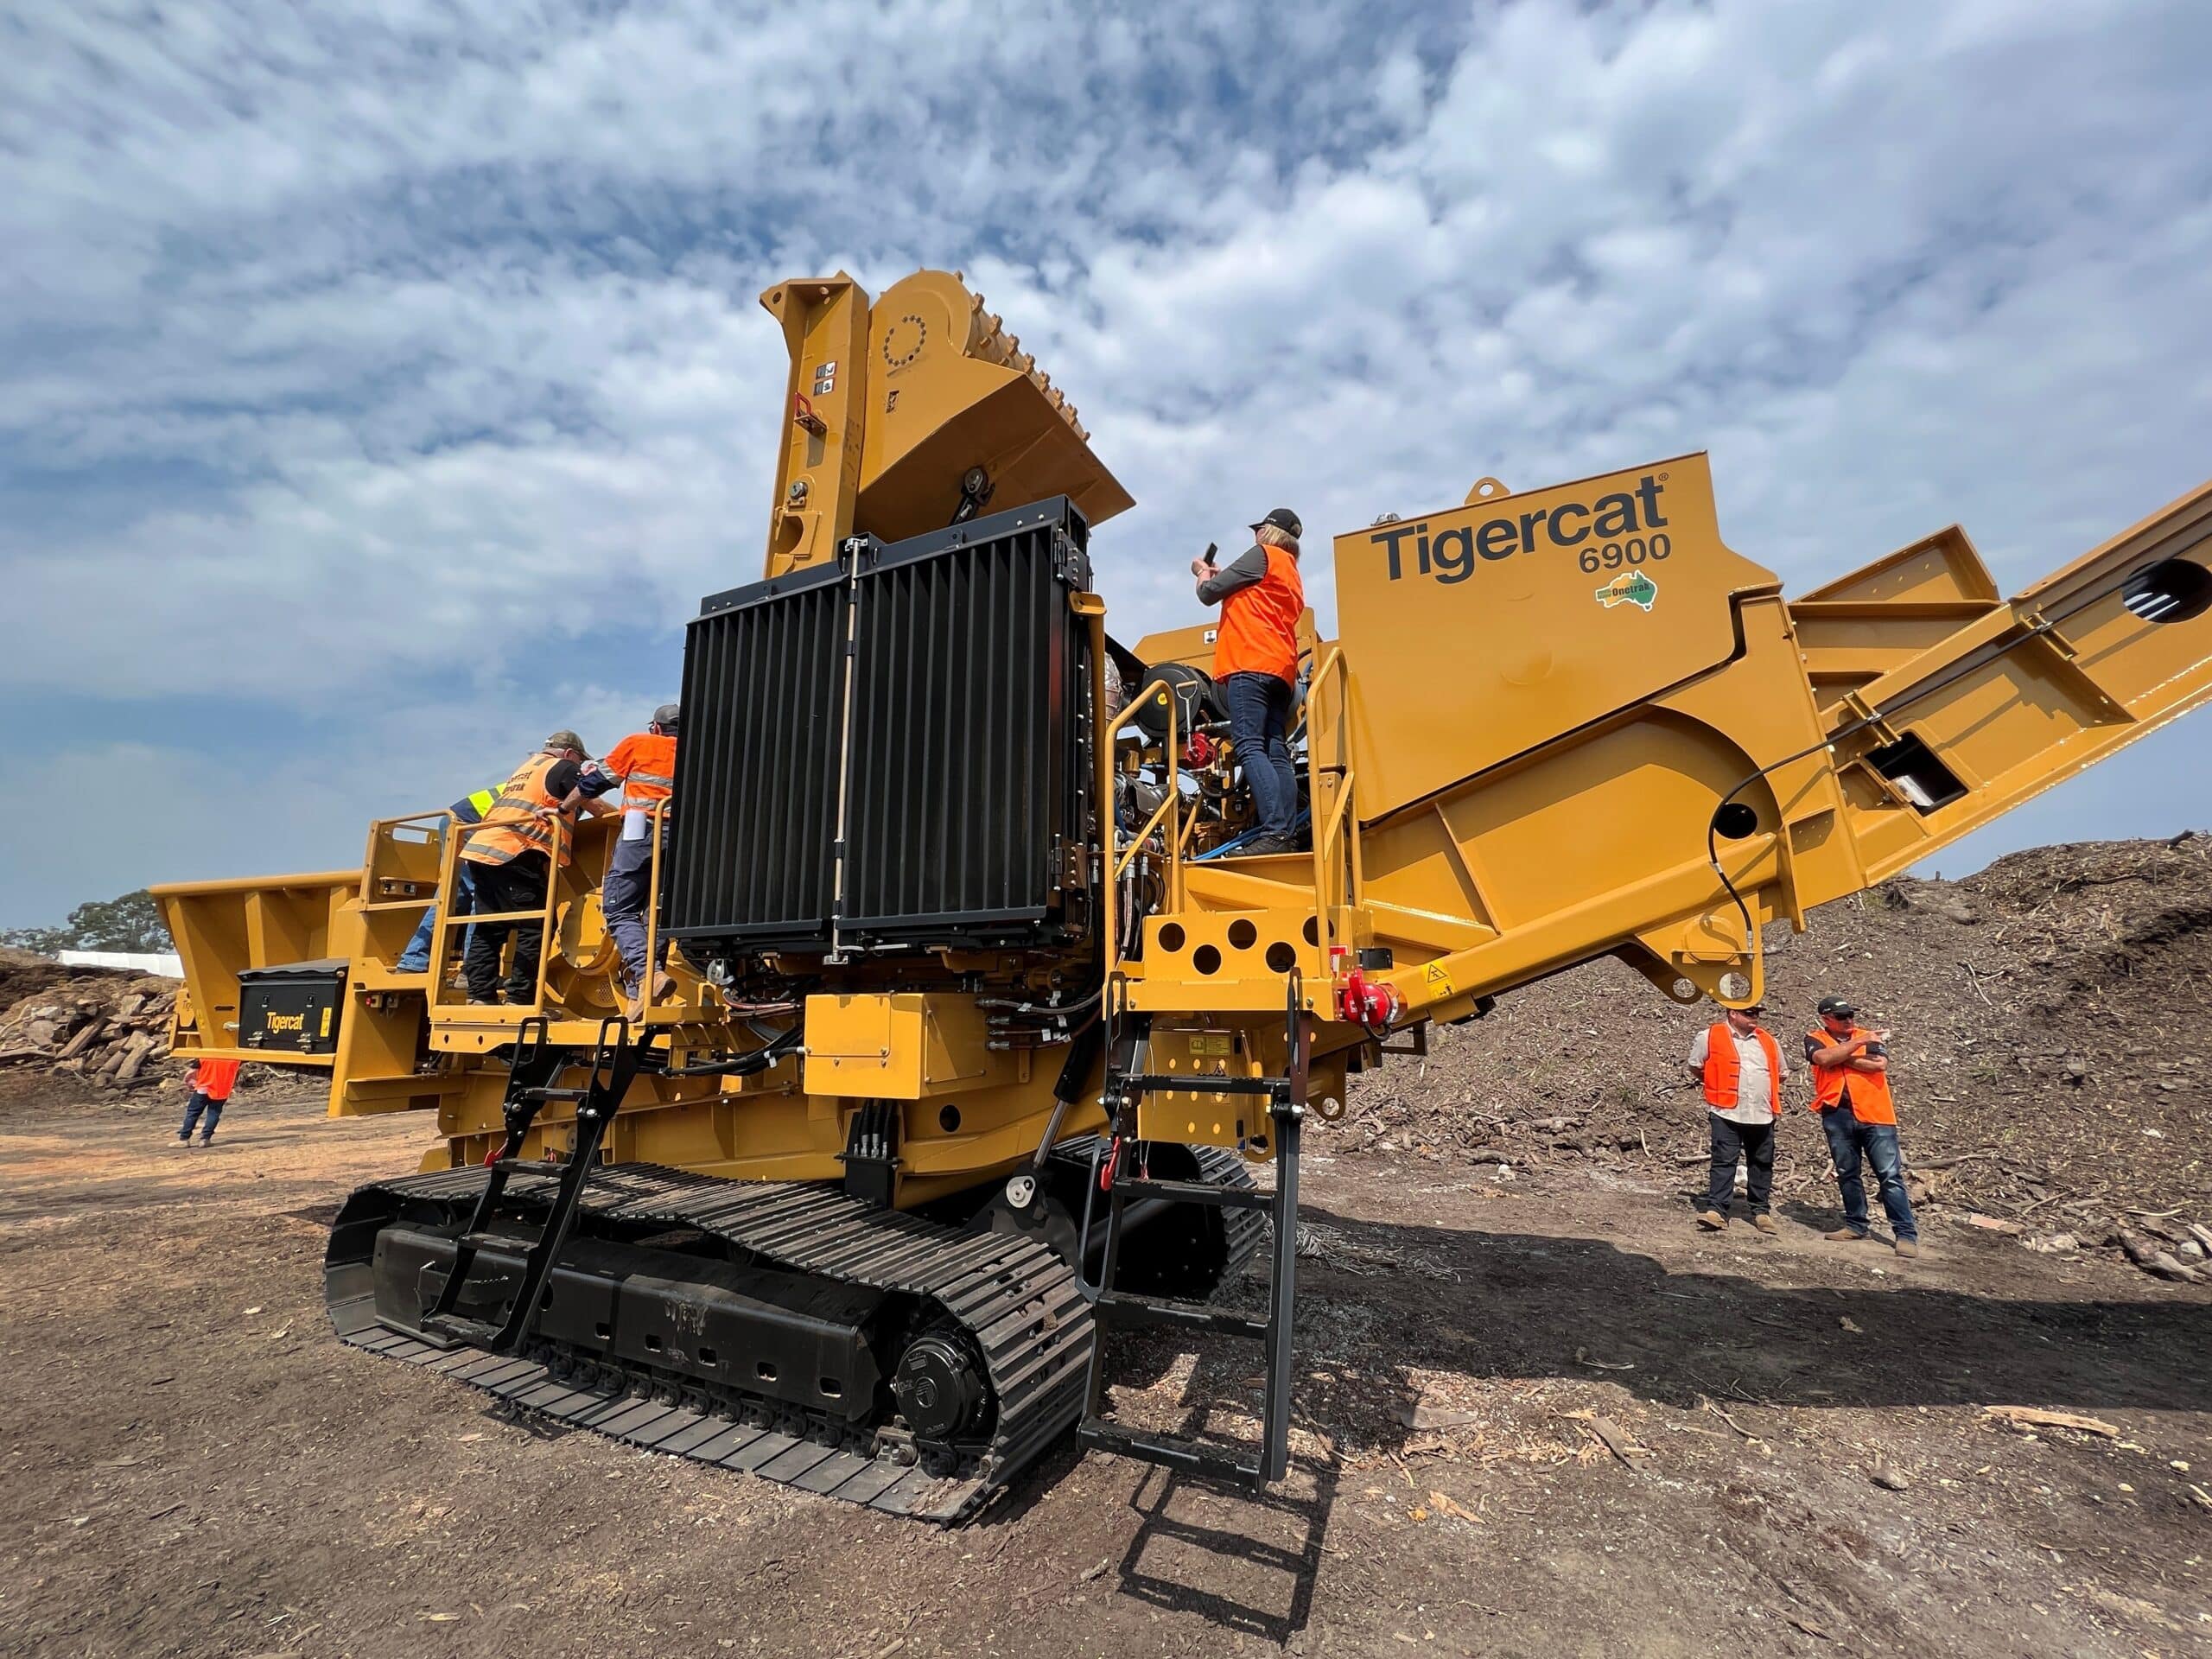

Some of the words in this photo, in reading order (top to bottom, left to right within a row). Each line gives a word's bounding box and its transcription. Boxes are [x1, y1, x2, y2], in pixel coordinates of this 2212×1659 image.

[1579, 533, 1671, 574] 6900
[1612, 582, 1650, 596] Onetrak
[266, 1011, 305, 1034] Tigercat
